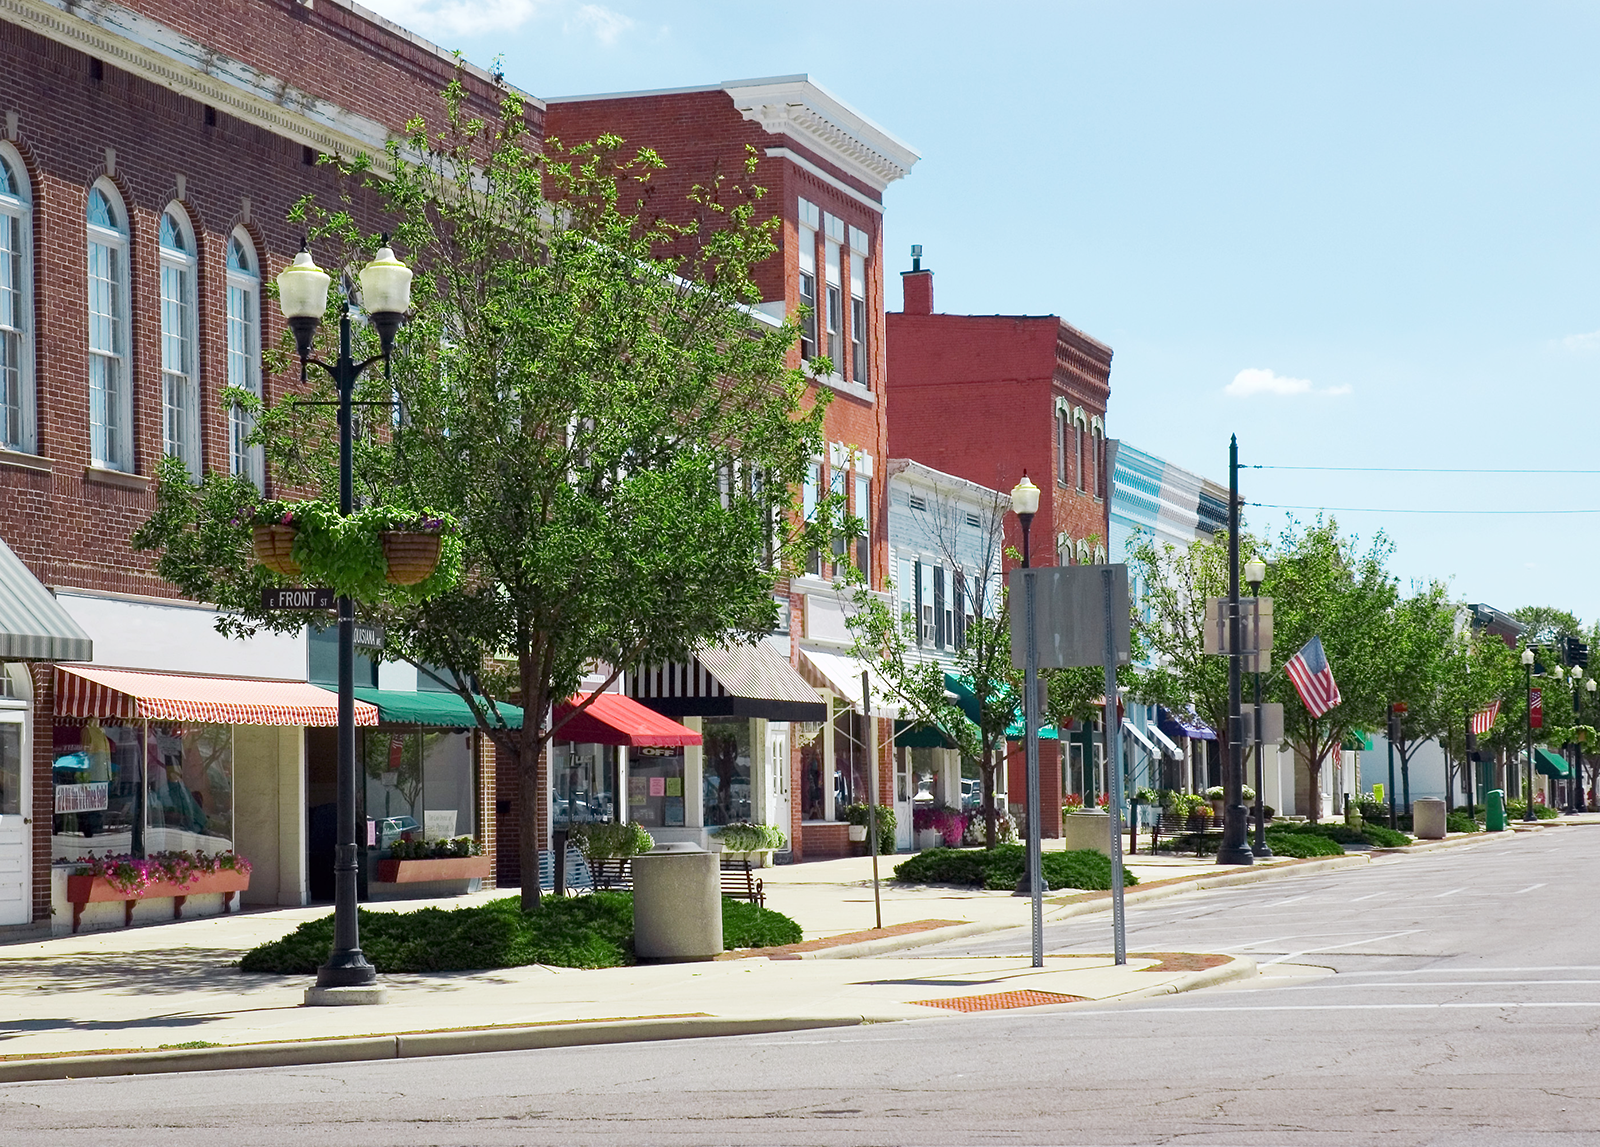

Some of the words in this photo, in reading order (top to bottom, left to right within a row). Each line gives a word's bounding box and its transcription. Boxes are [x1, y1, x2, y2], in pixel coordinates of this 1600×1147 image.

[270, 598, 274, 607] E
[279, 591, 316, 607] FRONT
[320, 598, 328, 607] ST
[353, 628, 376, 645] OUISIANA
[642, 748, 674, 757] OFF
